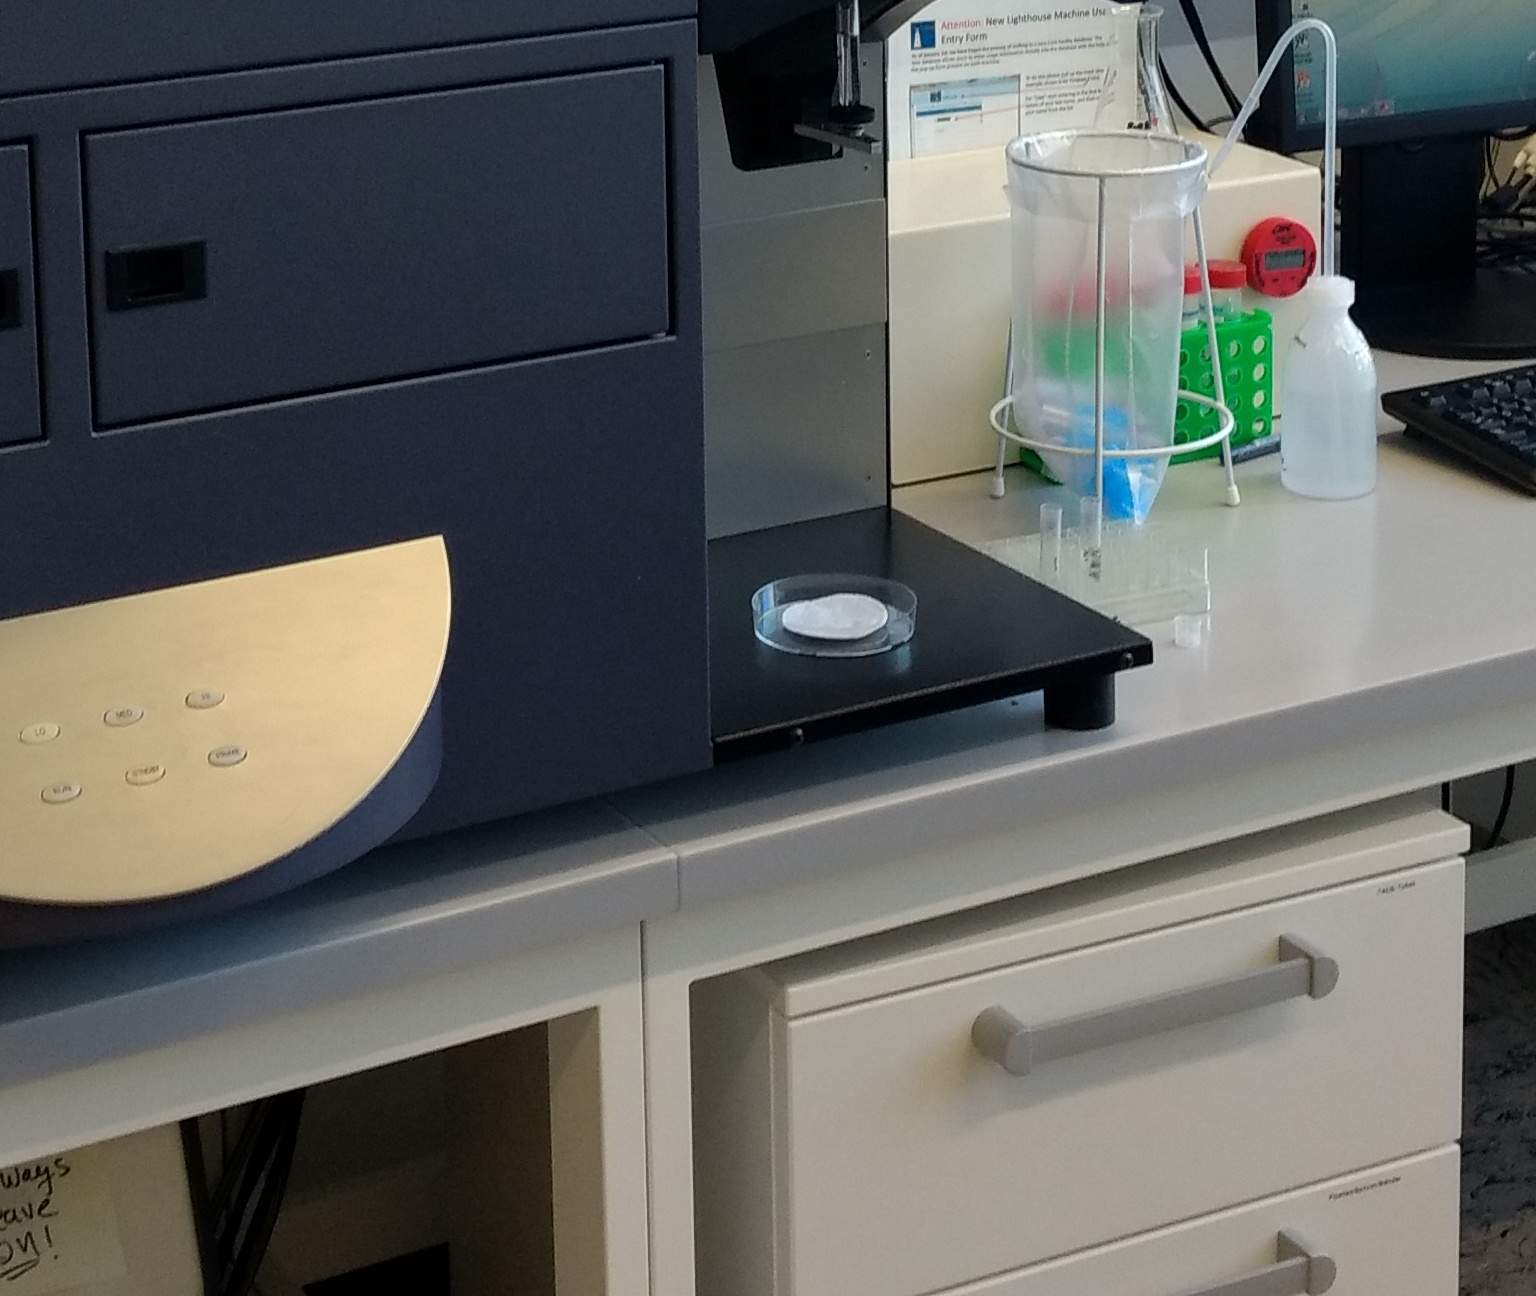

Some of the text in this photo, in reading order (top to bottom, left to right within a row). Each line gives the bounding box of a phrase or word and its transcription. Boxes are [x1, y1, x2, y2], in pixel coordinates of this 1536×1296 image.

[986, 17, 1004, 27] New
[1007, 12, 1052, 26] Lighthouse
[1054, 8, 1090, 20] Machine
[940, 32, 988, 45] Entry Form
